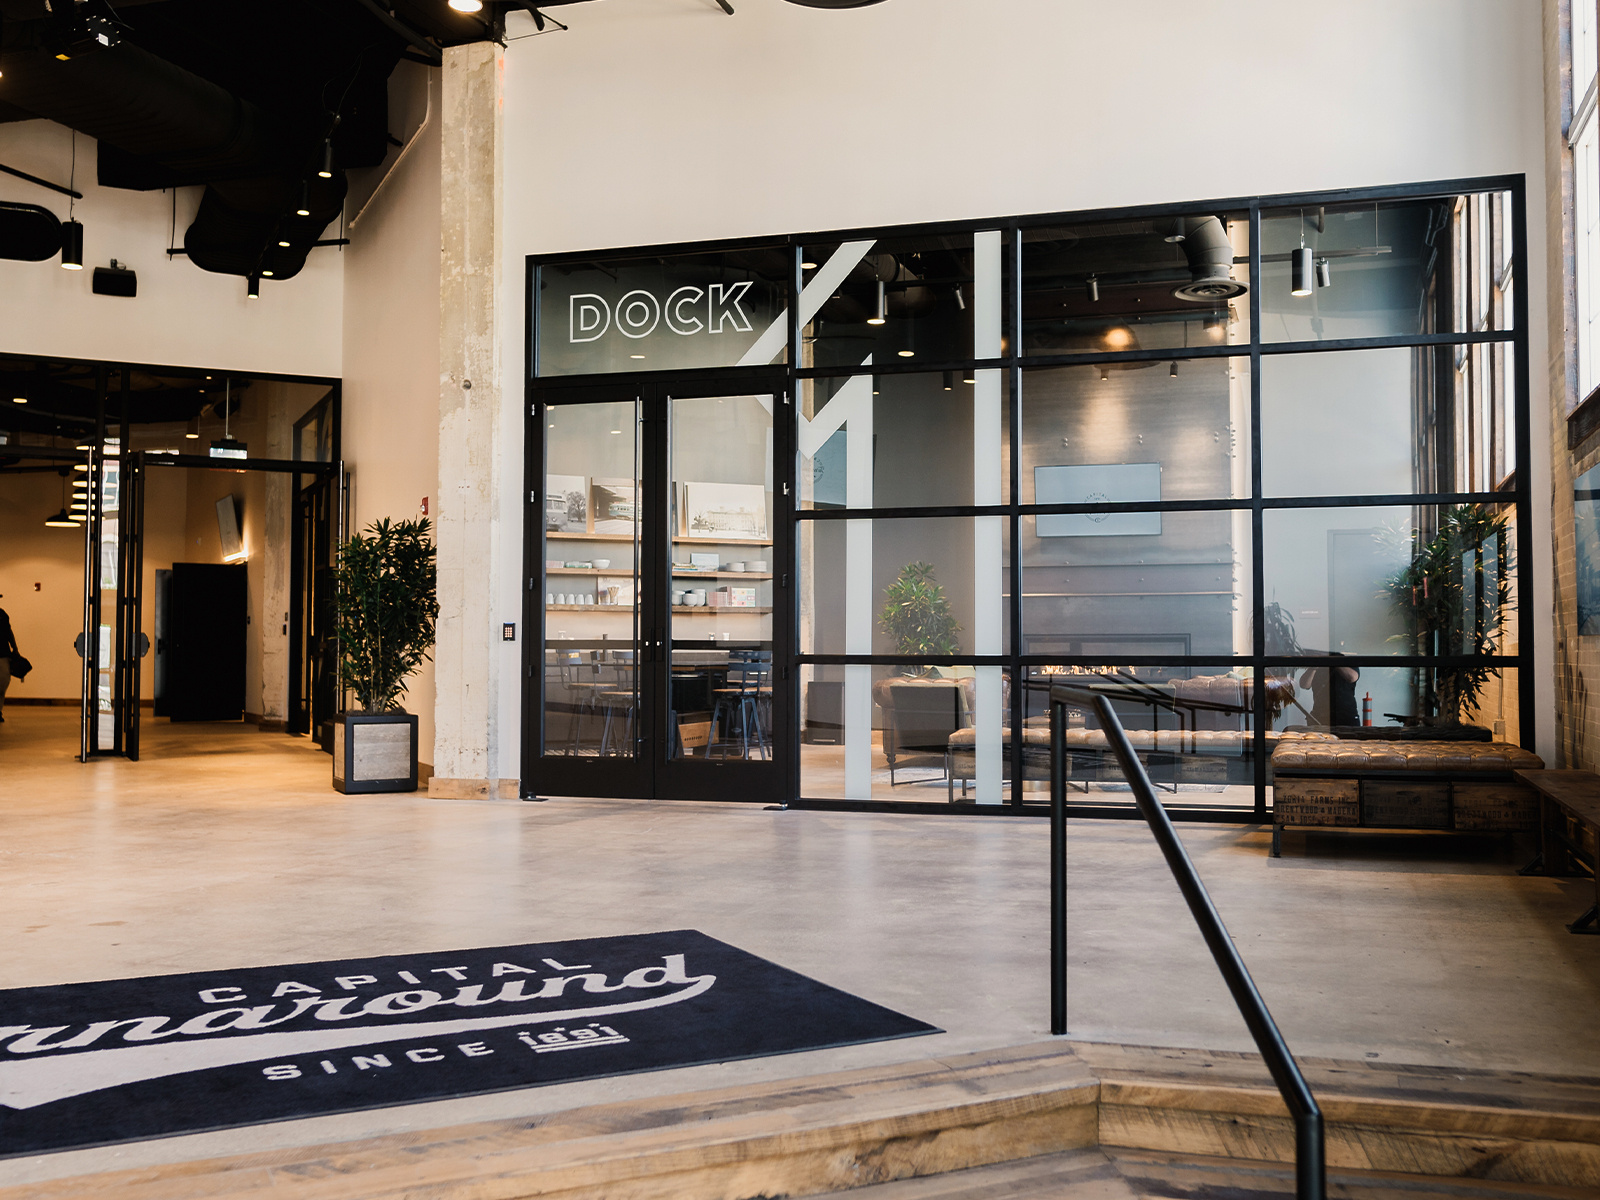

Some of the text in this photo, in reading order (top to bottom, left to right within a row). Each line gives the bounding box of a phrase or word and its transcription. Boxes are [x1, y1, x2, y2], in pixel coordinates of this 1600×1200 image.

[569, 281, 754, 344] DOCK
[1310, 795, 1334, 805] FARMS
[1327, 806, 1356, 816] MADERA
[198, 957, 592, 1004] CAPITAL
[263, 1024, 623, 1081] SINCE 1891
